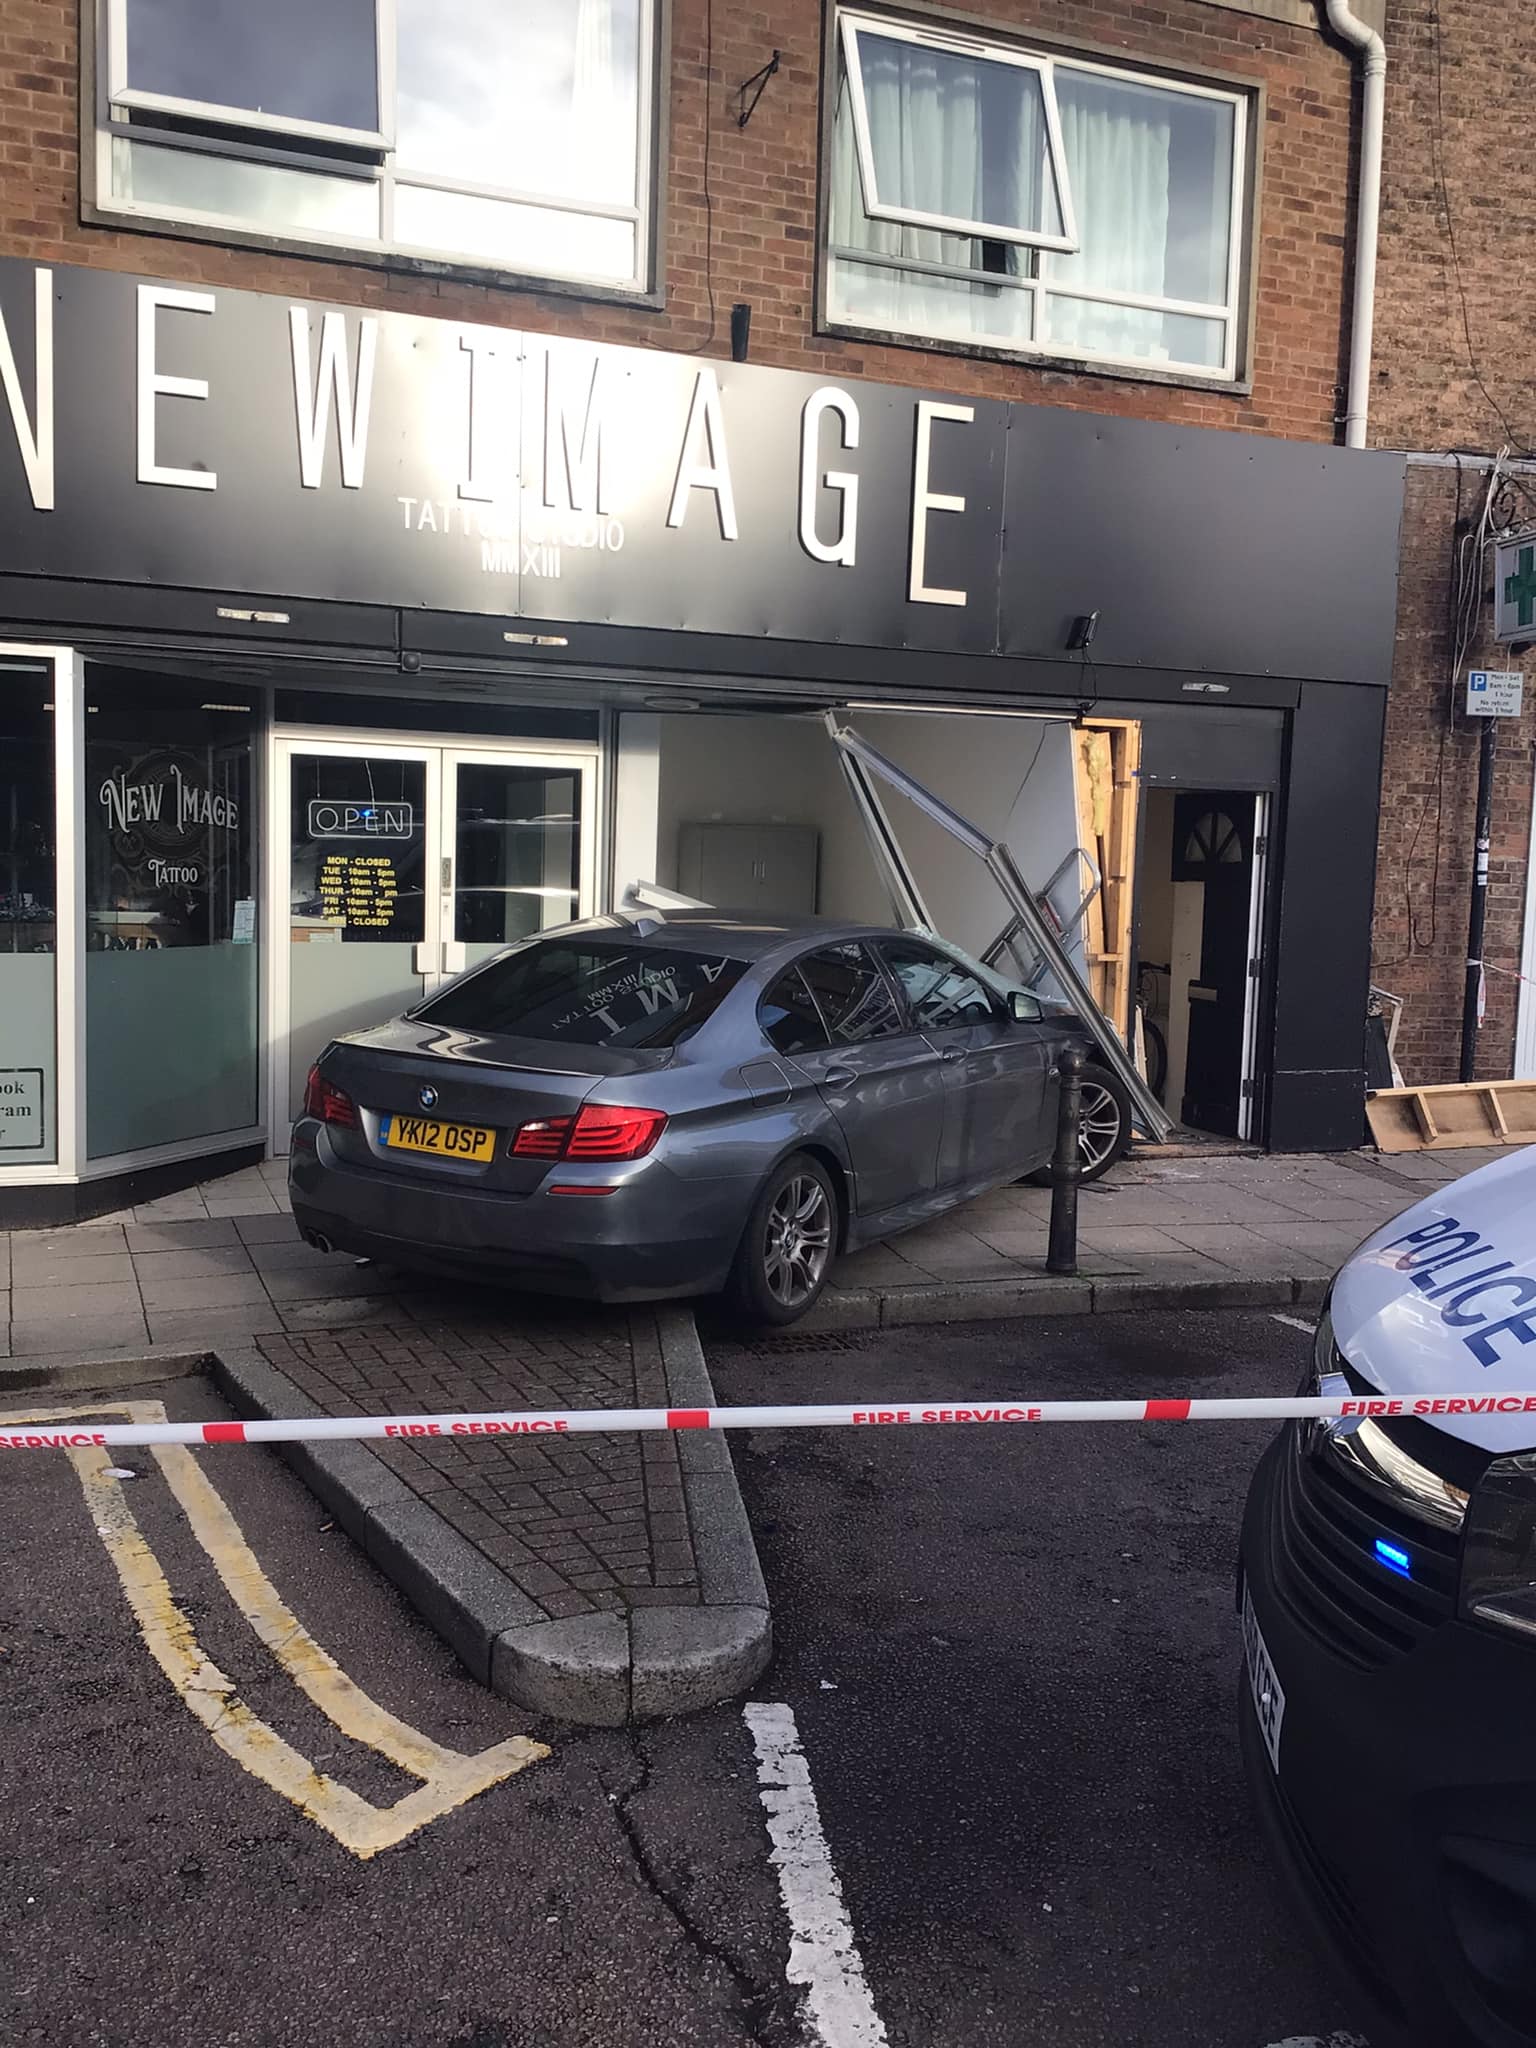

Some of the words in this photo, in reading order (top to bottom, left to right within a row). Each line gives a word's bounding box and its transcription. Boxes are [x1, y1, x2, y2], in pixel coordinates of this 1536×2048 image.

[0, 267, 378, 511] NEW
[457, 336, 975, 607] IMAGE
[398, 497, 519, 543] TATT
[526, 508, 625, 552] UDIO
[481, 540, 561, 578] MMXIII
[1474, 675, 1485, 690] P
[100, 774, 164, 833] NEW
[170, 764, 239, 834] IMAGE
[316, 807, 404, 833] OPEN
[327, 856, 348, 865] MON
[355, 857, 391, 867] CLOSED
[322, 866, 341, 875] TUE
[348, 867, 370, 876] 10am
[321, 876, 342, 885] WED
[349, 877, 372, 886] 10am
[319, 886, 345, 895] THUR
[351, 886, 373, 896] 10am
[324, 896, 339, 905] FRI
[346, 897, 368, 906] 10am
[322, 906, 340, 915] SAT
[347, 907, 370, 916] 10am
[353, 917, 389, 927] CLOSED
[0, 1080, 25, 1095] ok
[398, 1118, 441, 1148] YK12
[445, 1126, 487, 1154] OSP
[1379, 1217, 1536, 1369] POLICE
[1341, 1401, 1403, 1416] FIRE
[1413, 1396, 1536, 1415] SERVICE
[852, 1411, 912, 1425] FIRE
[921, 1408, 1042, 1424] SERVICE
[384, 1423, 442, 1437] FIRE
[451, 1420, 569, 1436] SERVICE
[0, 1434, 107, 1448] SERVICE
